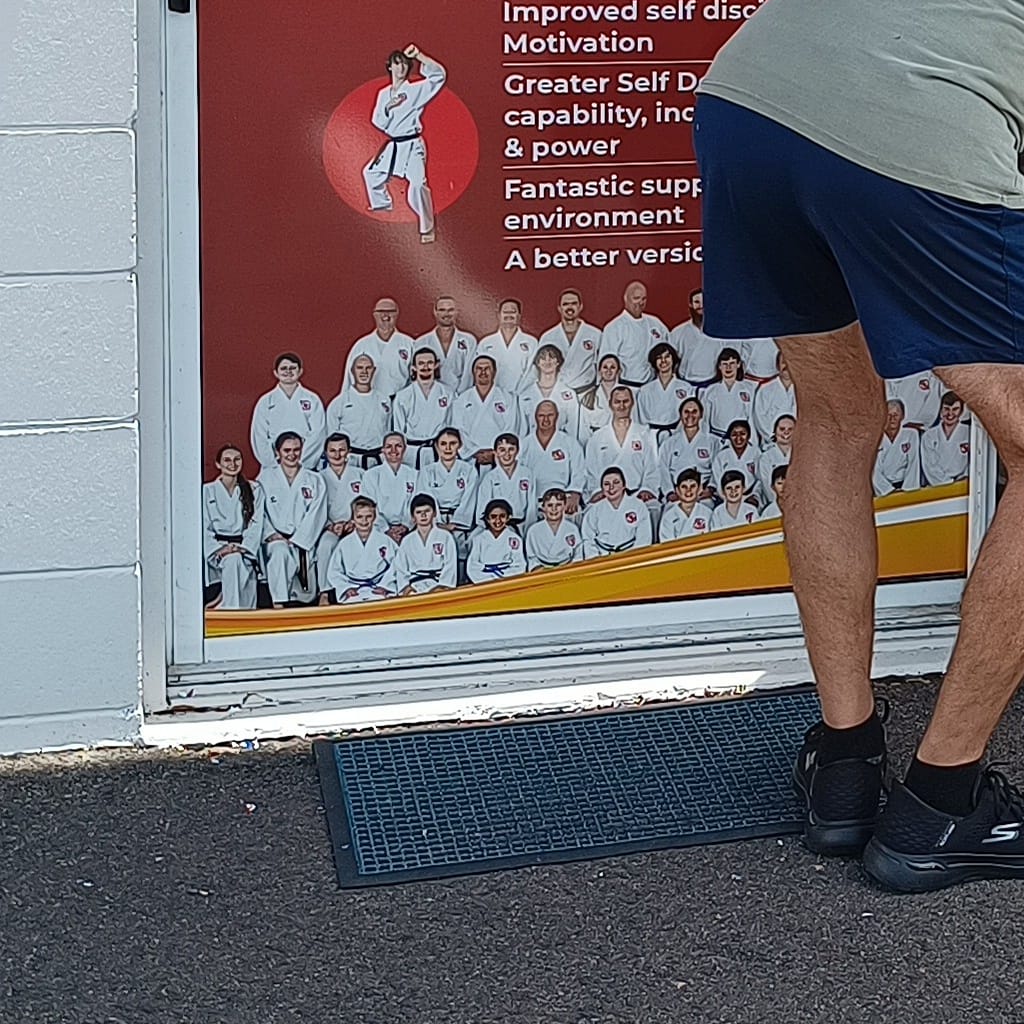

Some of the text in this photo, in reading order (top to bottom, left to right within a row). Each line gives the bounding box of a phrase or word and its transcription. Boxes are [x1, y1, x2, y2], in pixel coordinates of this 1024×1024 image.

[503, 0, 638, 26] Improved
[503, 31, 654, 55] Motivation
[504, 73, 609, 96] Greater
[617, 70, 670, 94] Self
[503, 102, 648, 129] capability,
[504, 136, 621, 163] & power
[505, 173, 634, 199] Fantastic
[504, 205, 685, 232] environment
[504, 248, 527, 271] A
[533, 244, 620, 269] better
